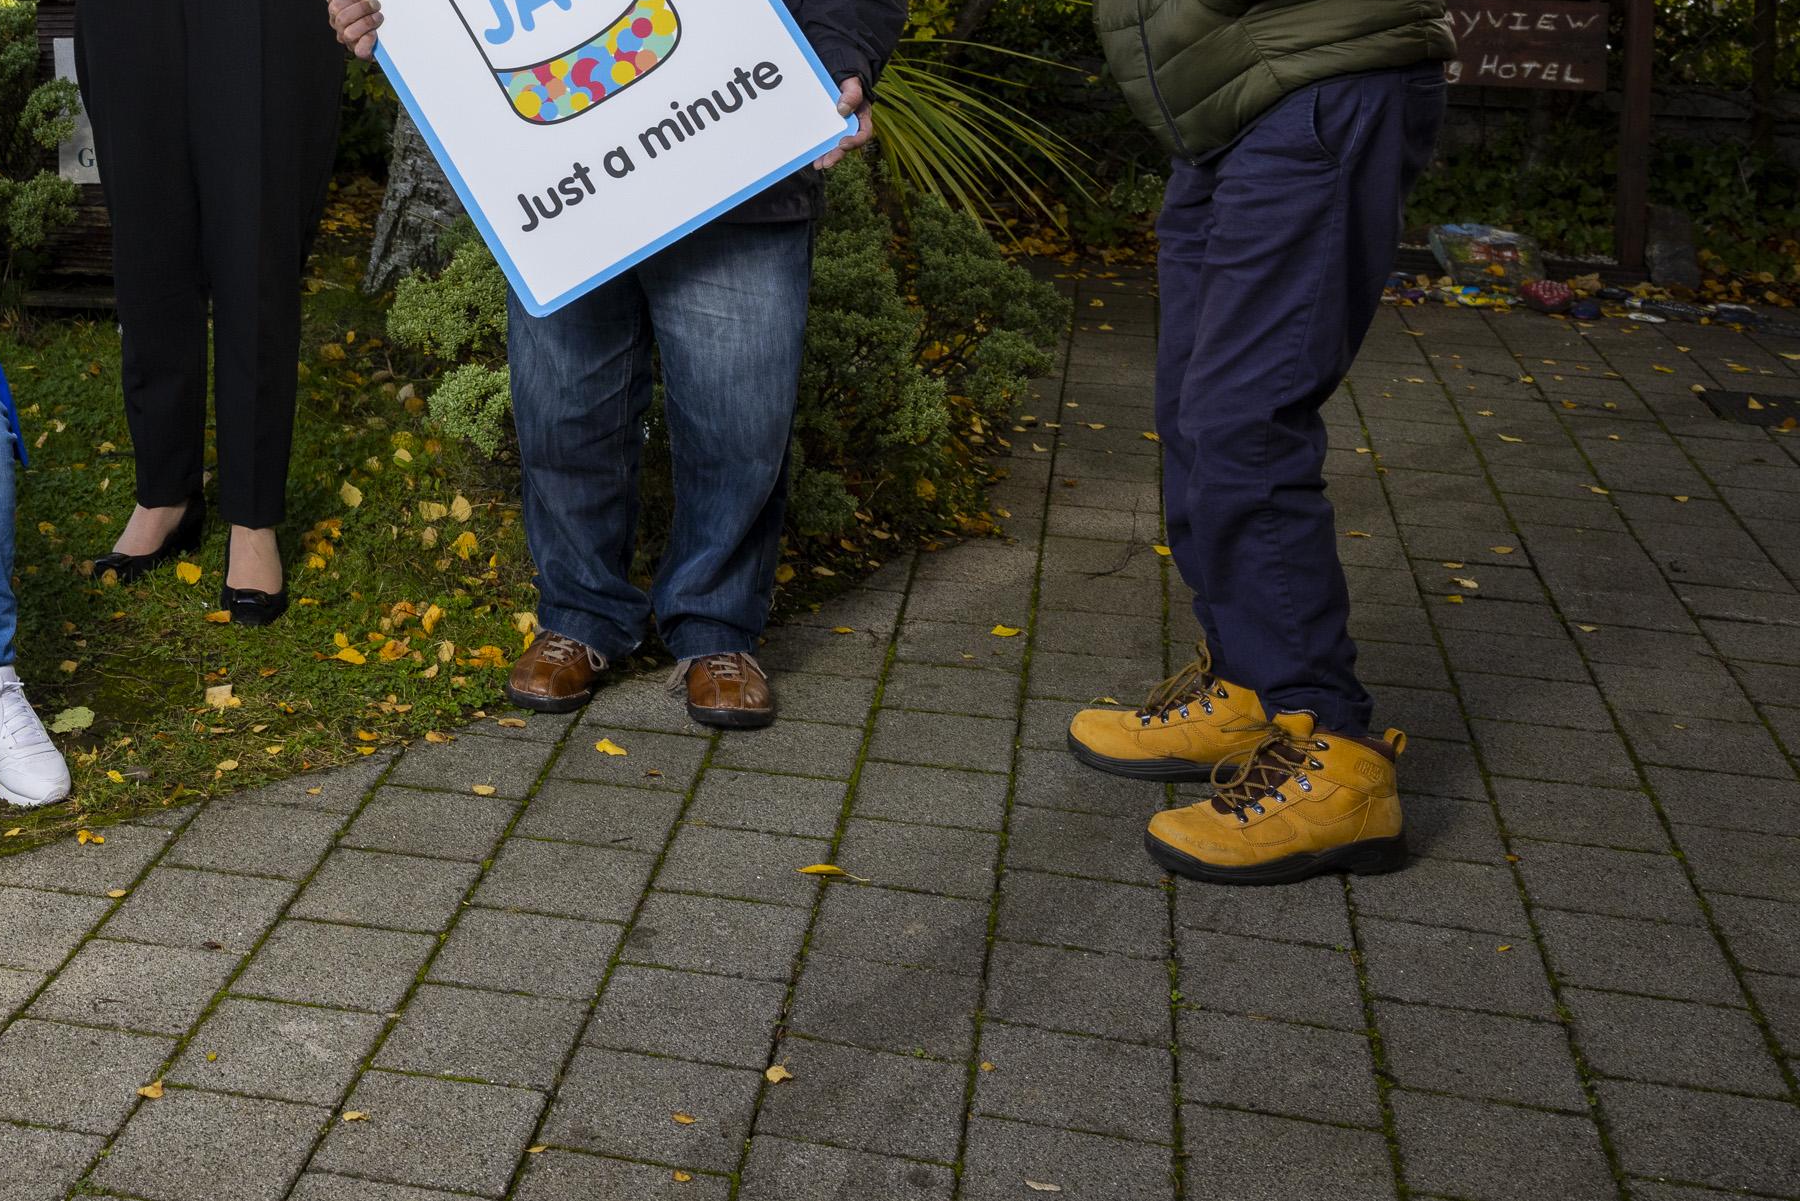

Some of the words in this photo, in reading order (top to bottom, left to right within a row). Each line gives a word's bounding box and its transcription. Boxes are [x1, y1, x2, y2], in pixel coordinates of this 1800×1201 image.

[1444, 9, 1600, 37] AYVIEW
[1479, 54, 1584, 84] HOTEL
[518, 163, 595, 232] Just
[604, 146, 635, 178] a
[639, 62, 782, 158] minute
